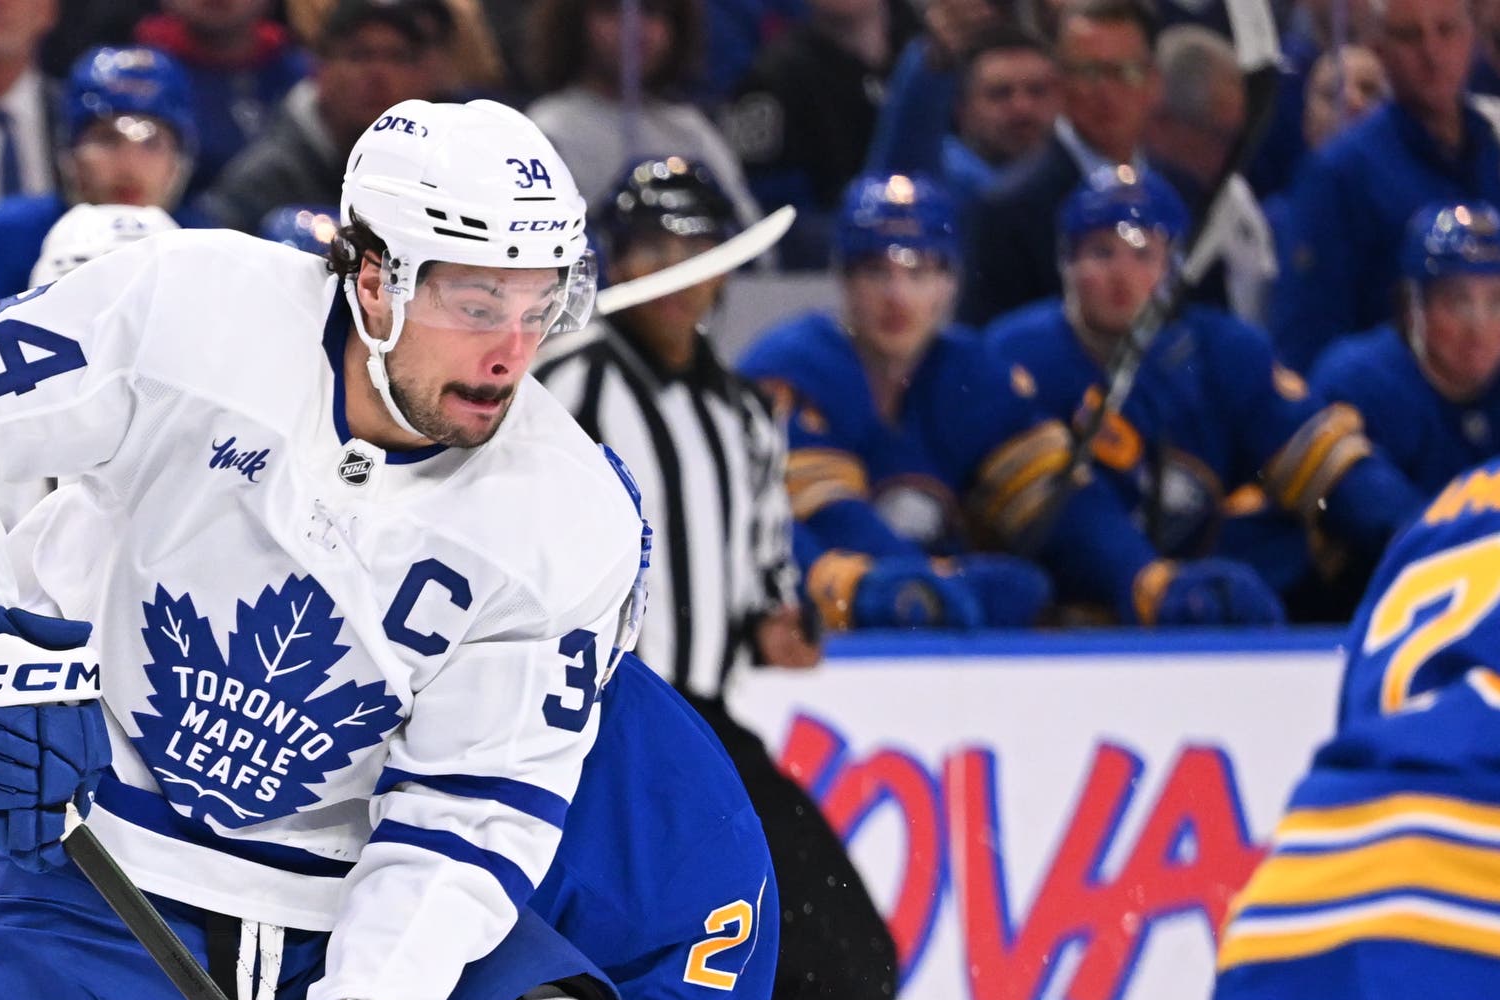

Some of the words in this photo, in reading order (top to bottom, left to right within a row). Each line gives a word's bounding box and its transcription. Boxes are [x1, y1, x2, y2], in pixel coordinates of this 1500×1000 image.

[506, 158, 552, 190] 34
[508, 219, 568, 232] CCM
[342, 463, 368, 476] NHL
[381, 557, 474, 657] C
[171, 665, 335, 762] TORONTO
[541, 627, 603, 734] 3
[164, 730, 282, 803] LEAFS
[179, 700, 298, 776] MAPLE
